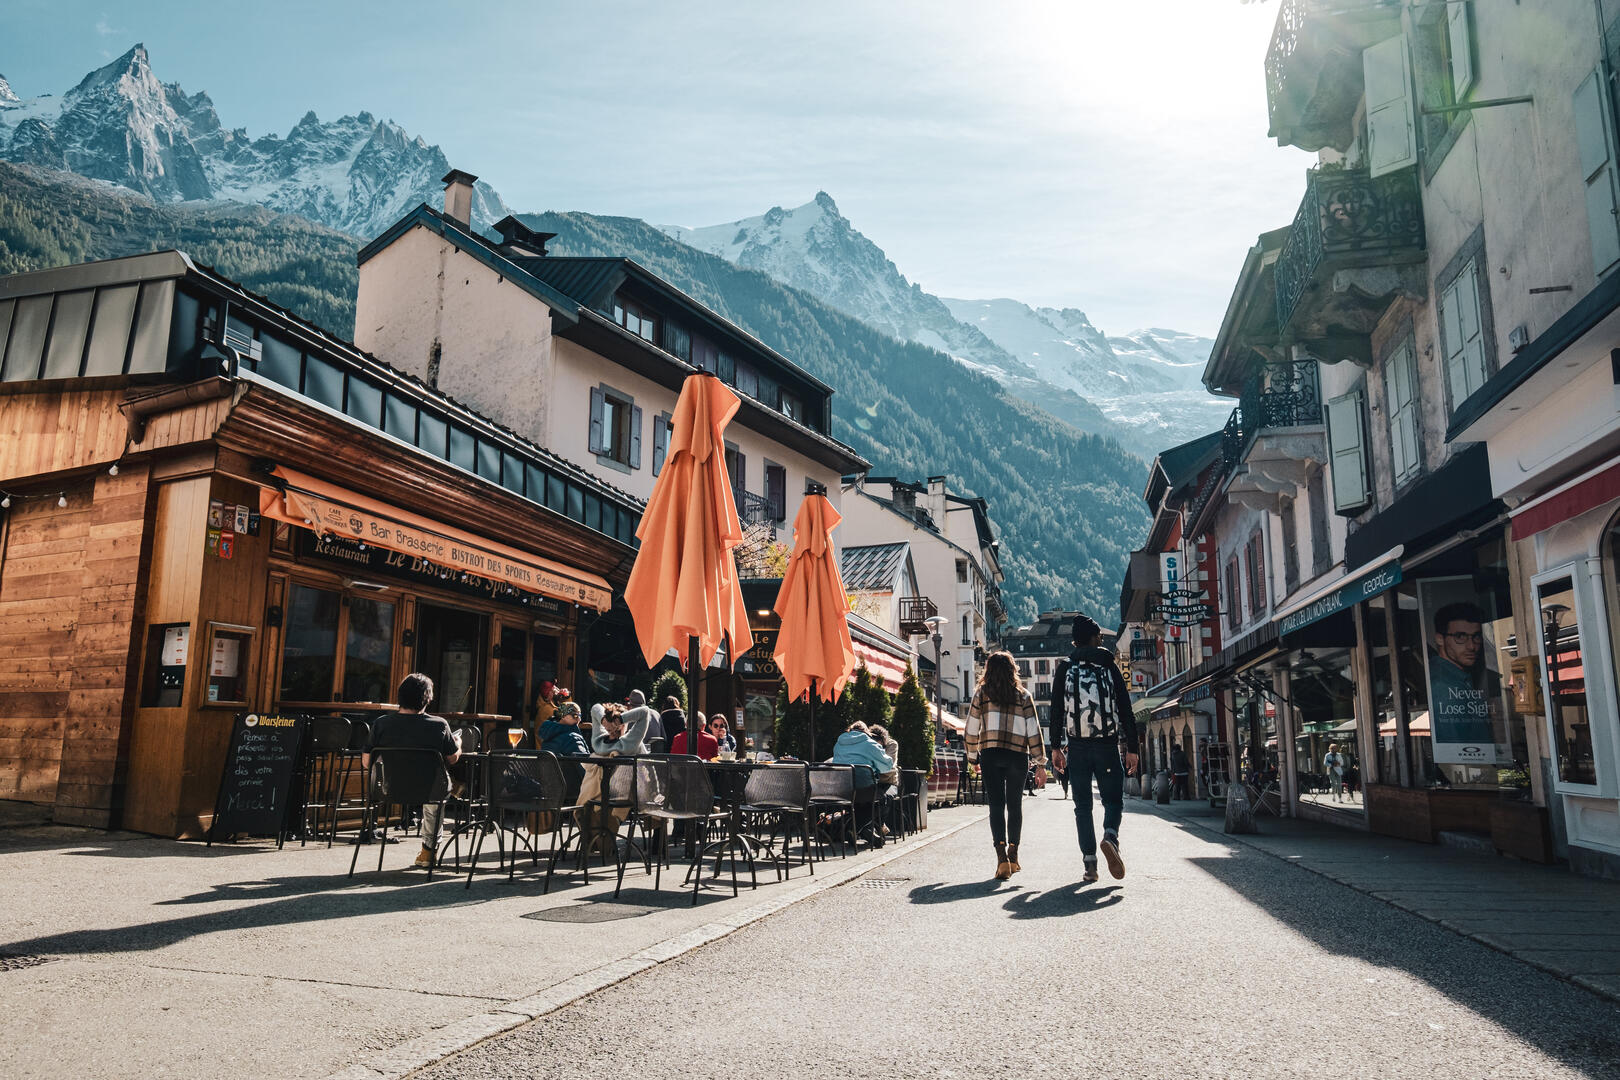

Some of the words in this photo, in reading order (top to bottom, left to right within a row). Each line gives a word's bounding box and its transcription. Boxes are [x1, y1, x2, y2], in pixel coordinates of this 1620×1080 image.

[315, 541, 370, 564] Restaurant
[370, 522, 391, 539] Bar
[396, 530, 444, 556] Brasserie
[451, 548, 484, 568] BISTROT
[488, 559, 501, 573] DES
[505, 565, 531, 582] SPORTS
[536, 573, 576, 595] Restaurant
[385, 551, 406, 567] Le
[1168, 590, 1192, 598] PAYOT
[1156, 605, 1207, 614] CHAUSSURES
[755, 633, 769, 644] Le
[1448, 686, 1484, 700] Never
[1439, 702, 1465, 715] Lose
[1467, 701, 1497, 718] Sight
